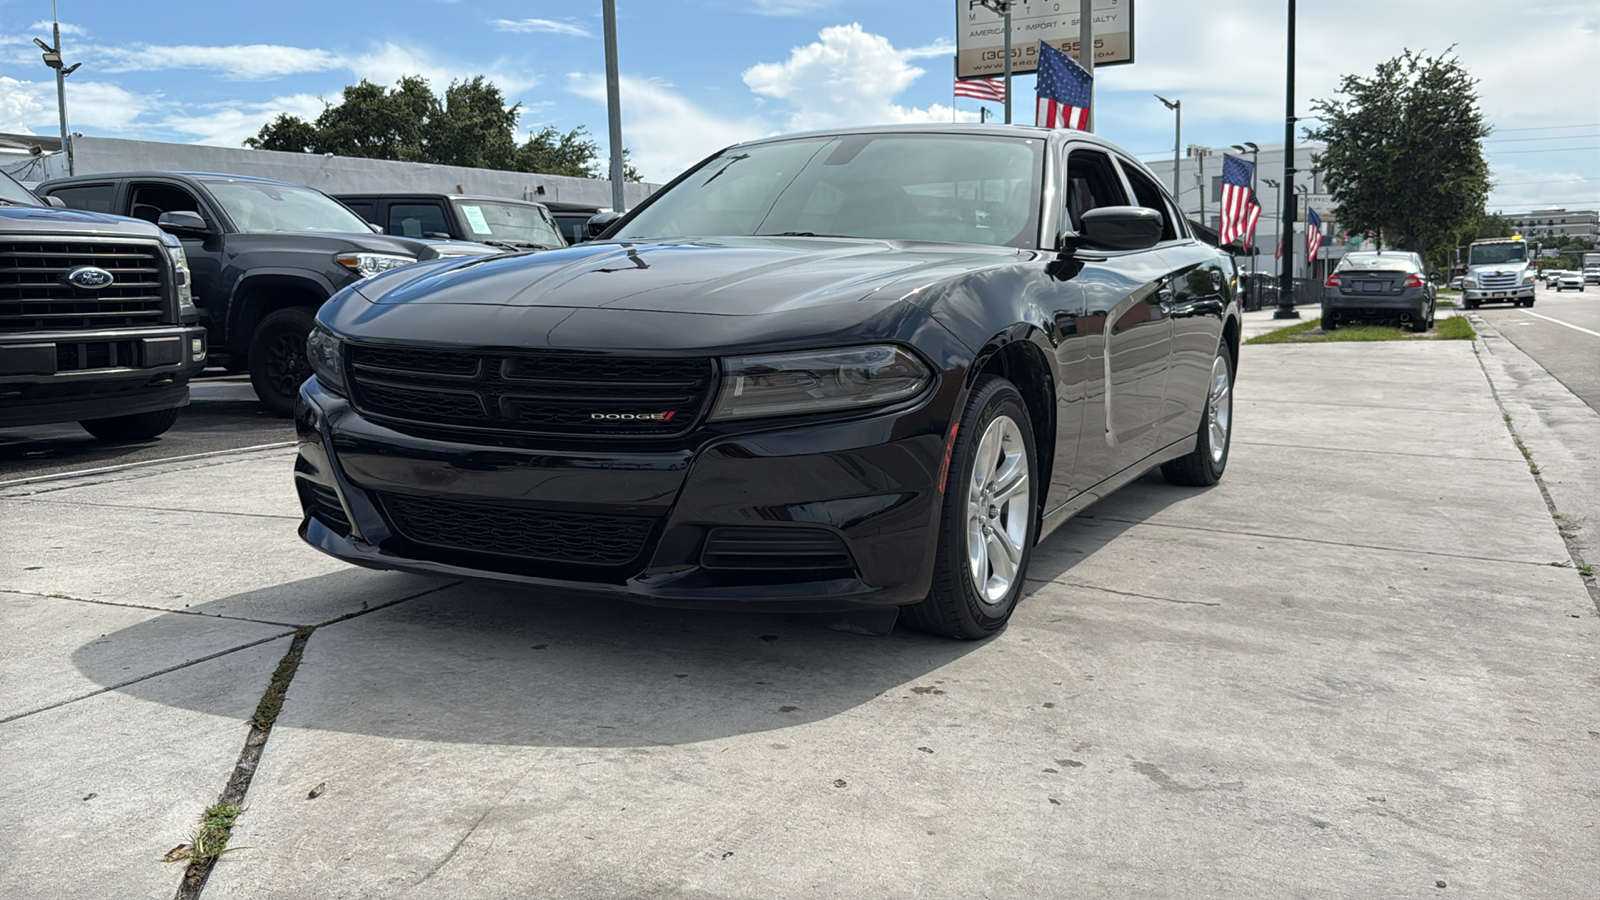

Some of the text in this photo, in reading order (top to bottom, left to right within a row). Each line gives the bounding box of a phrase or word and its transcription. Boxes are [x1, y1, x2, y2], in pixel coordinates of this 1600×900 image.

[970, 15, 1117, 37] AMERICA IMPORT SPIALTY
[982, 48, 1022, 61] (305)
[81, 272, 104, 284] Ford
